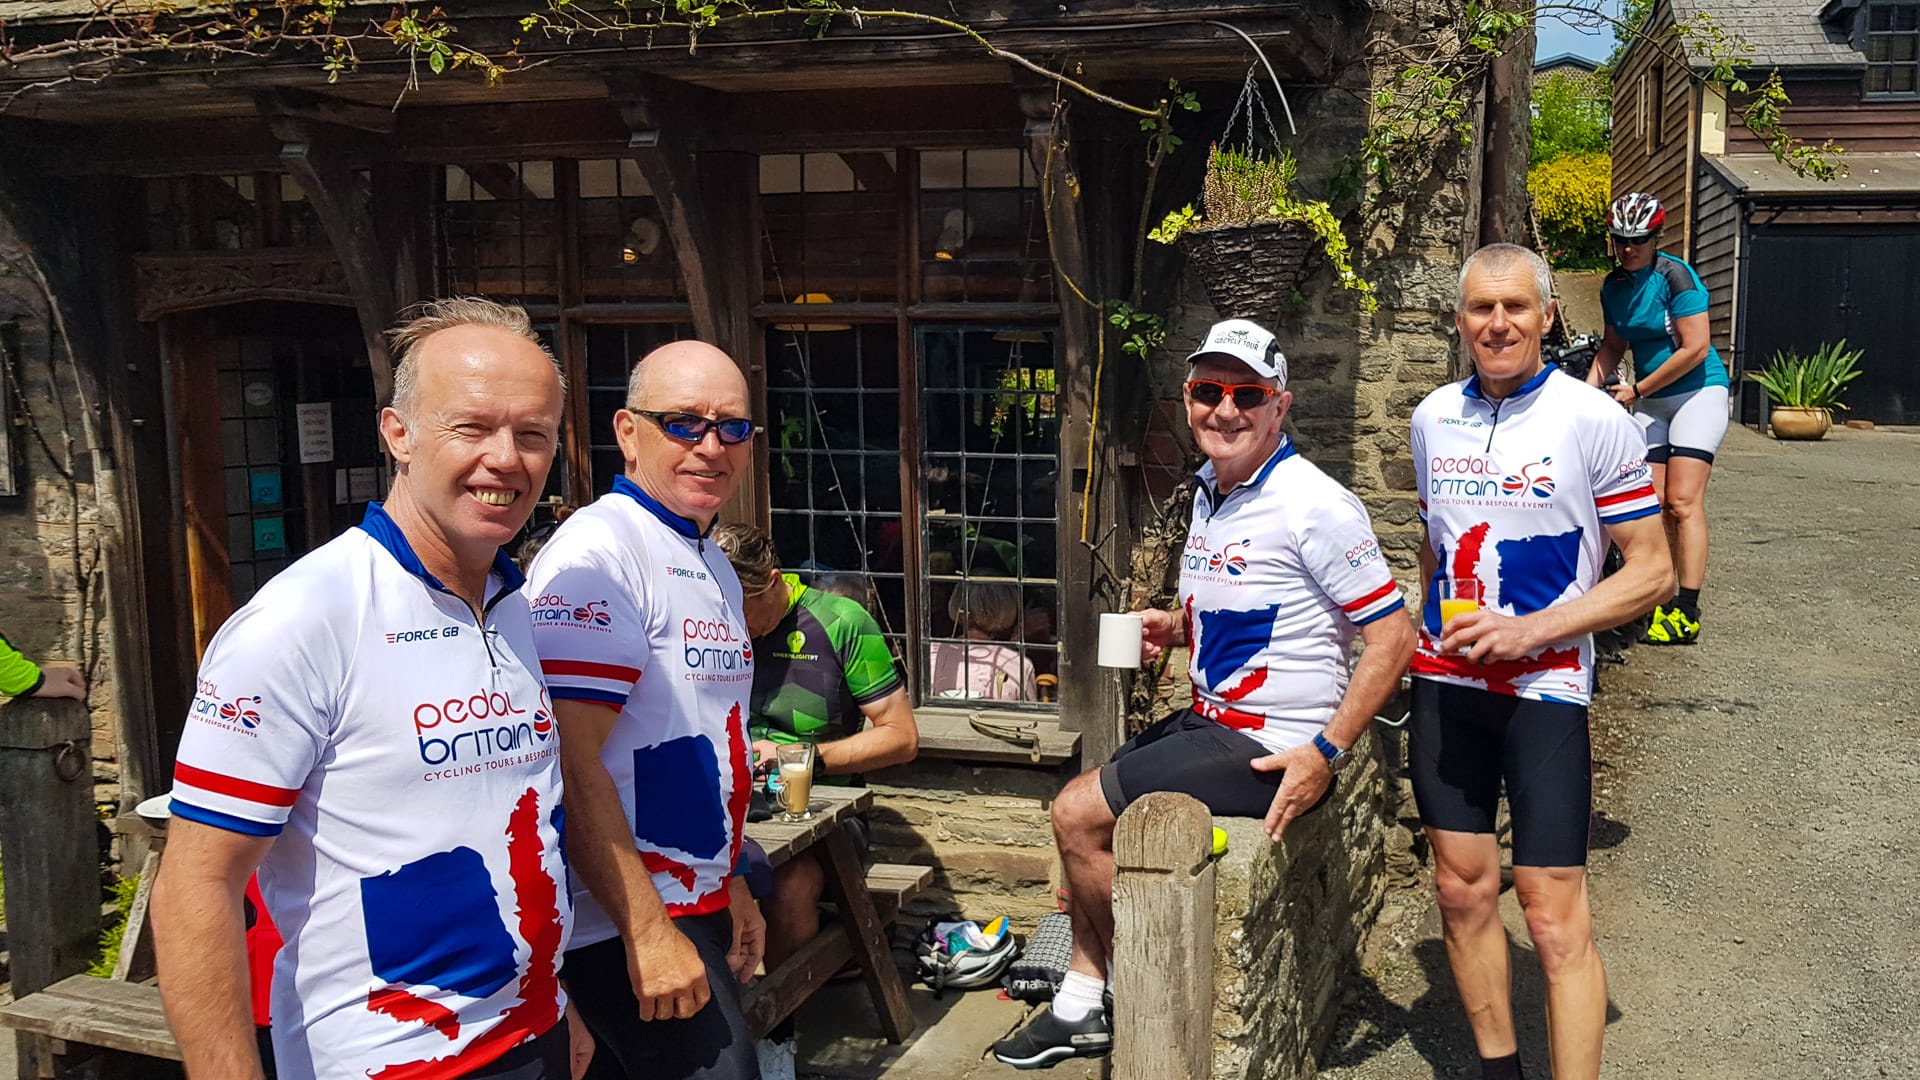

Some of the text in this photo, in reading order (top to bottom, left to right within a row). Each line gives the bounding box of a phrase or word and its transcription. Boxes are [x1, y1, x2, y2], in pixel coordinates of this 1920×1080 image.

[1243, 340, 1259, 351] TOUR
[1431, 455, 1500, 477] pedal
[1431, 477, 1498, 497] britain
[1485, 500, 1519, 508] BESPOKE
[1522, 502, 1554, 510] EVENTS
[1345, 538, 1377, 560] peda
[673, 567, 707, 581] FORCE GB
[530, 593, 572, 609] edal
[396, 626, 459, 643] FORCE GB
[683, 618, 739, 643] pedal
[684, 643, 743, 670] britain
[684, 673, 716, 682] CYCLING
[414, 688, 526, 735] pedal
[205, 718, 231, 730] BESPOKE
[233, 726, 258, 738] EVENTS
[418, 722, 534, 765] britain
[424, 764, 481, 782] CYCLING
[485, 756, 514, 770] TOURS
[525, 747, 553, 763] BESPOKE
